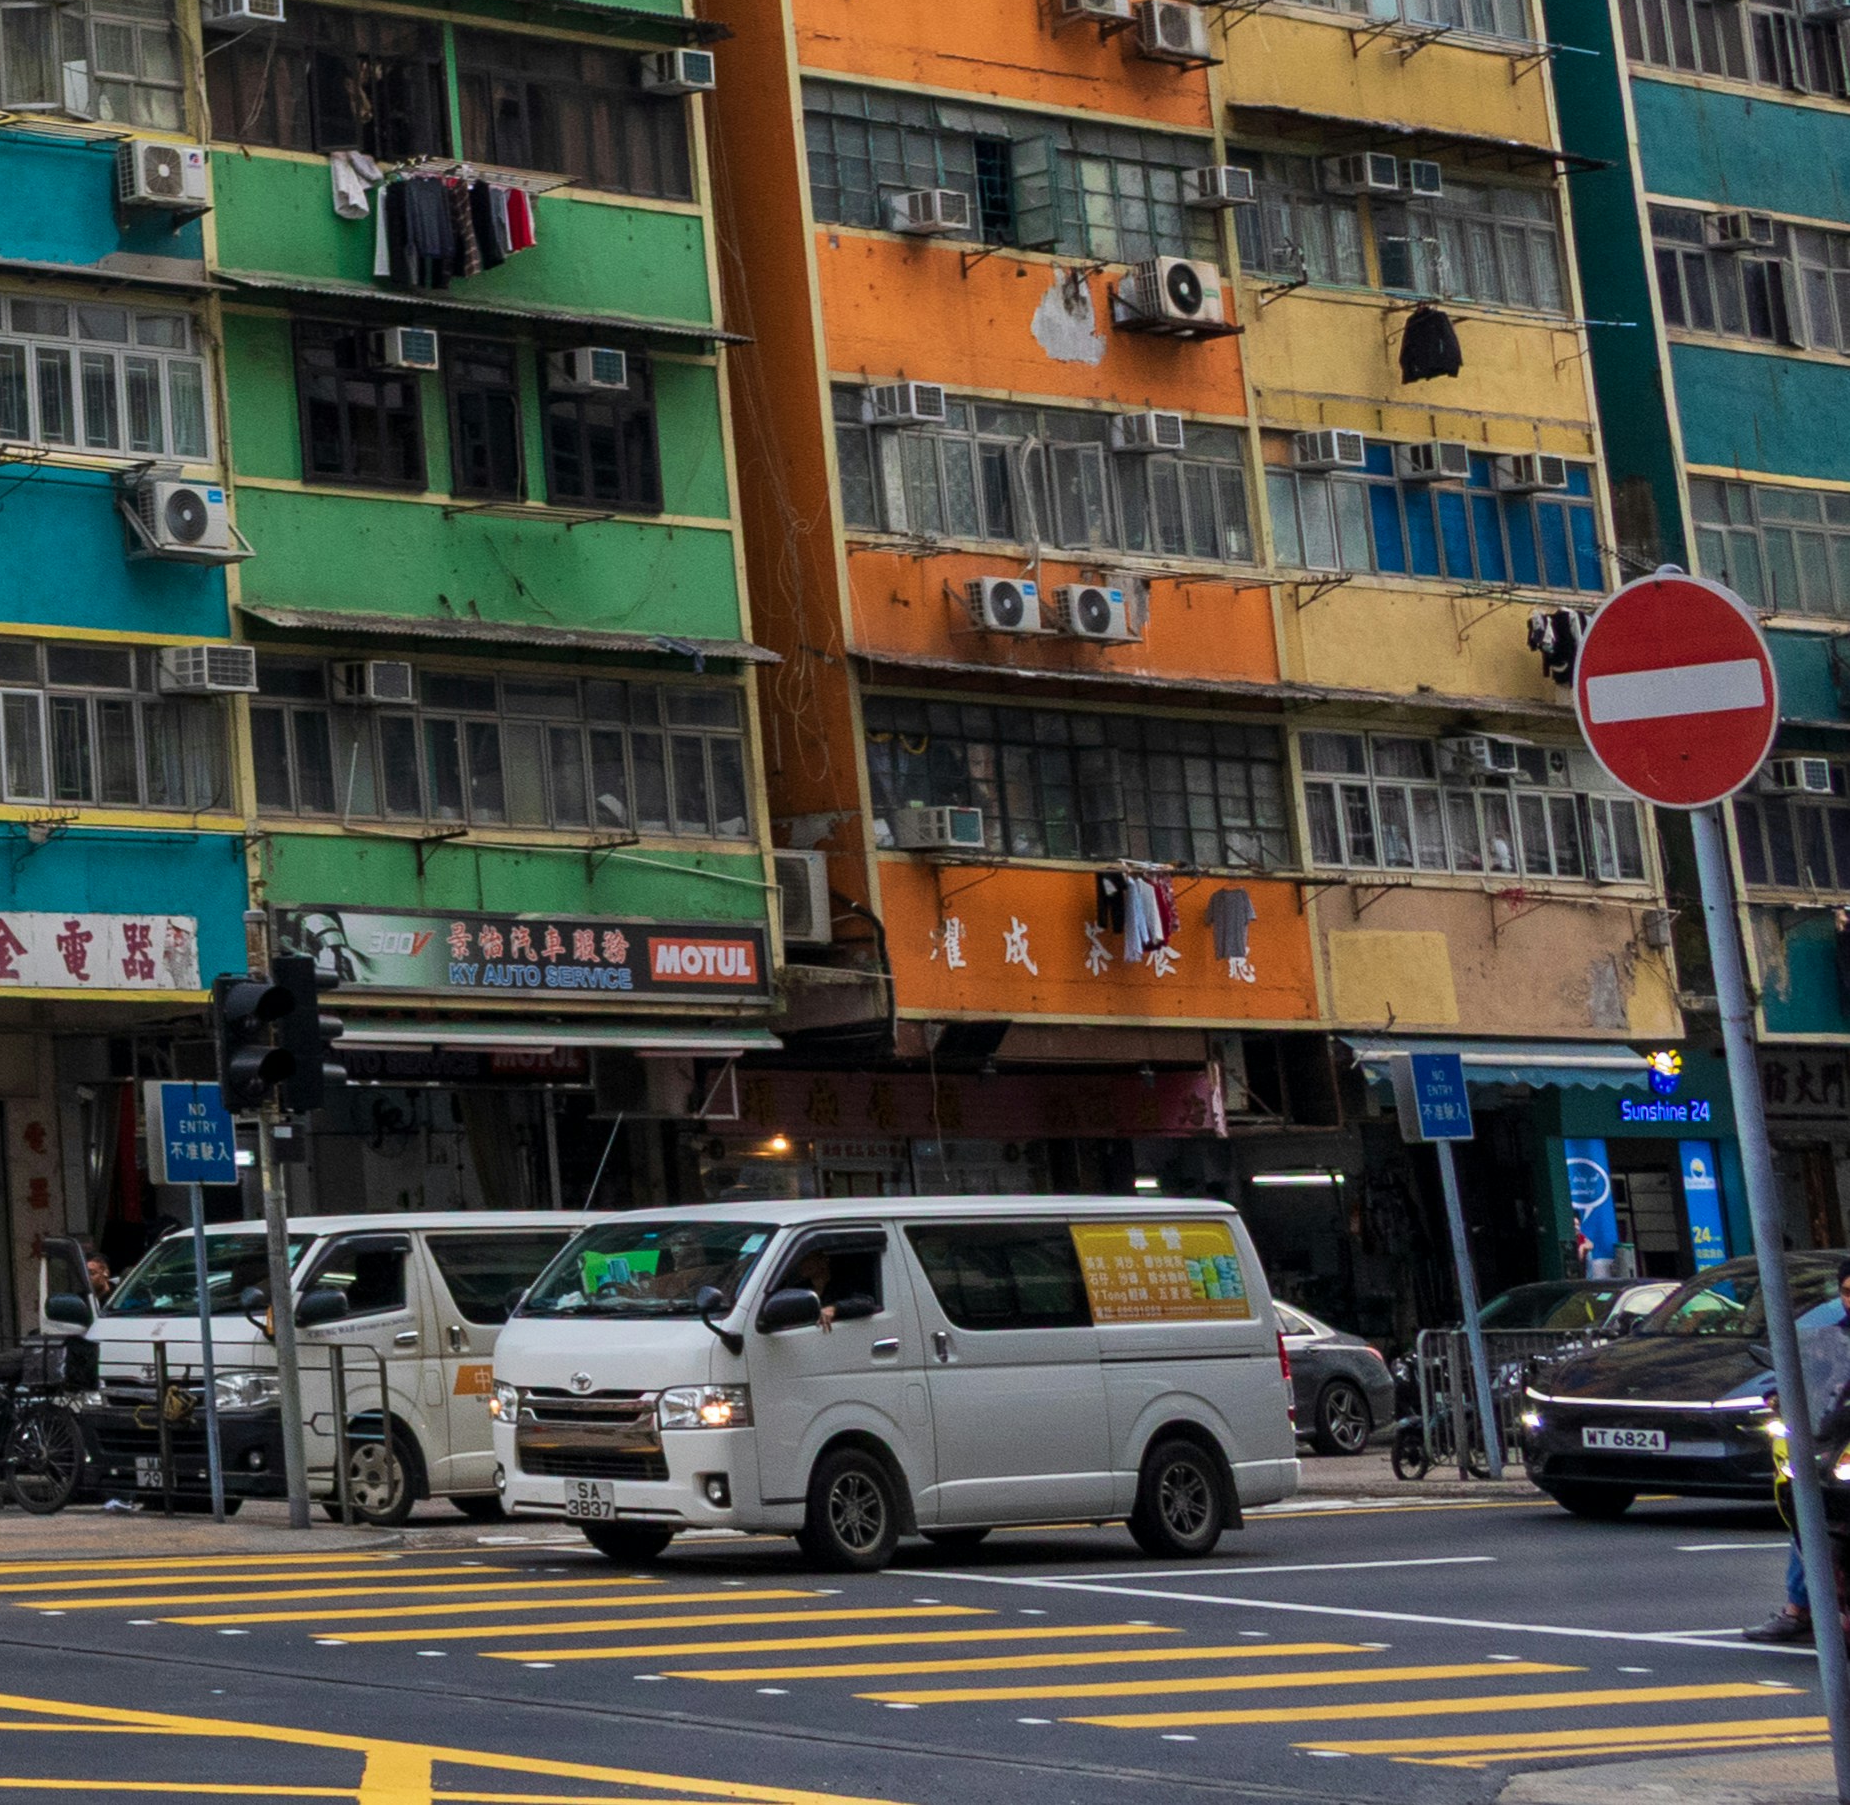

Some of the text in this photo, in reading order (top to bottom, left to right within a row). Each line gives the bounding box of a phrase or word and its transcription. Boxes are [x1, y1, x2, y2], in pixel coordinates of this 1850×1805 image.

[368, 931, 433, 957] 300V
[445, 921, 631, 965] 景怡汽車服務
[654, 944, 752, 978] MOTUL
[448, 963, 633, 990] KY AUTO SERVICE
[1431, 1069, 1446, 1082] NO
[1426, 1083, 1454, 1097] ENTRY
[187, 1102, 207, 1117] NO
[1621, 1100, 1711, 1123] Sunshine 24
[179, 1119, 219, 1135] ENTRY
[170, 1141, 232, 1162] 不准駛入
[1692, 1226, 1713, 1244] 24
[1586, 1429, 1661, 1448] WT 6824
[577, 1481, 601, 1500] SA
[567, 1499, 612, 1518] 3837
